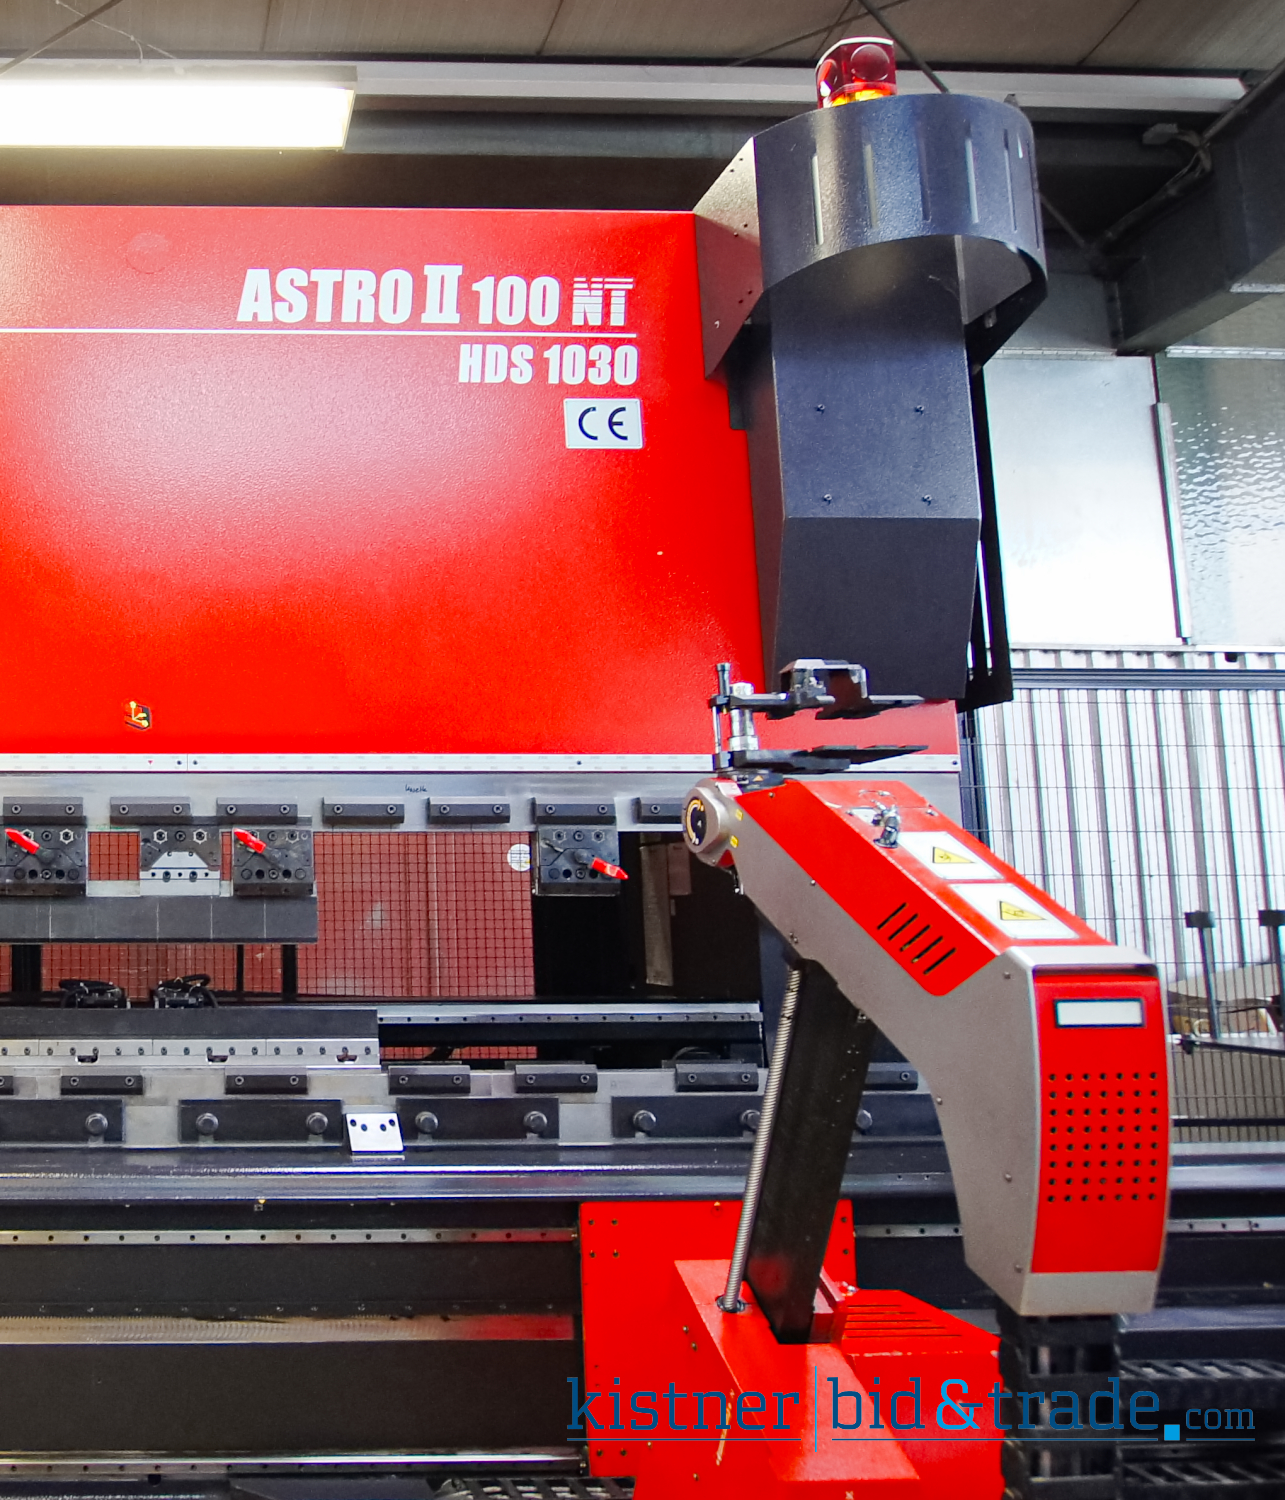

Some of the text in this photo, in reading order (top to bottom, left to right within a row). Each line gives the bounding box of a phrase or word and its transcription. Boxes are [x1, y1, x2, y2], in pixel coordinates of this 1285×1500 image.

[236, 268, 413, 323] ASTRO
[472, 275, 560, 325] 100
[572, 277, 634, 326] NT
[458, 344, 638, 385] HDS 1030
[578, 406, 628, 441] CE
